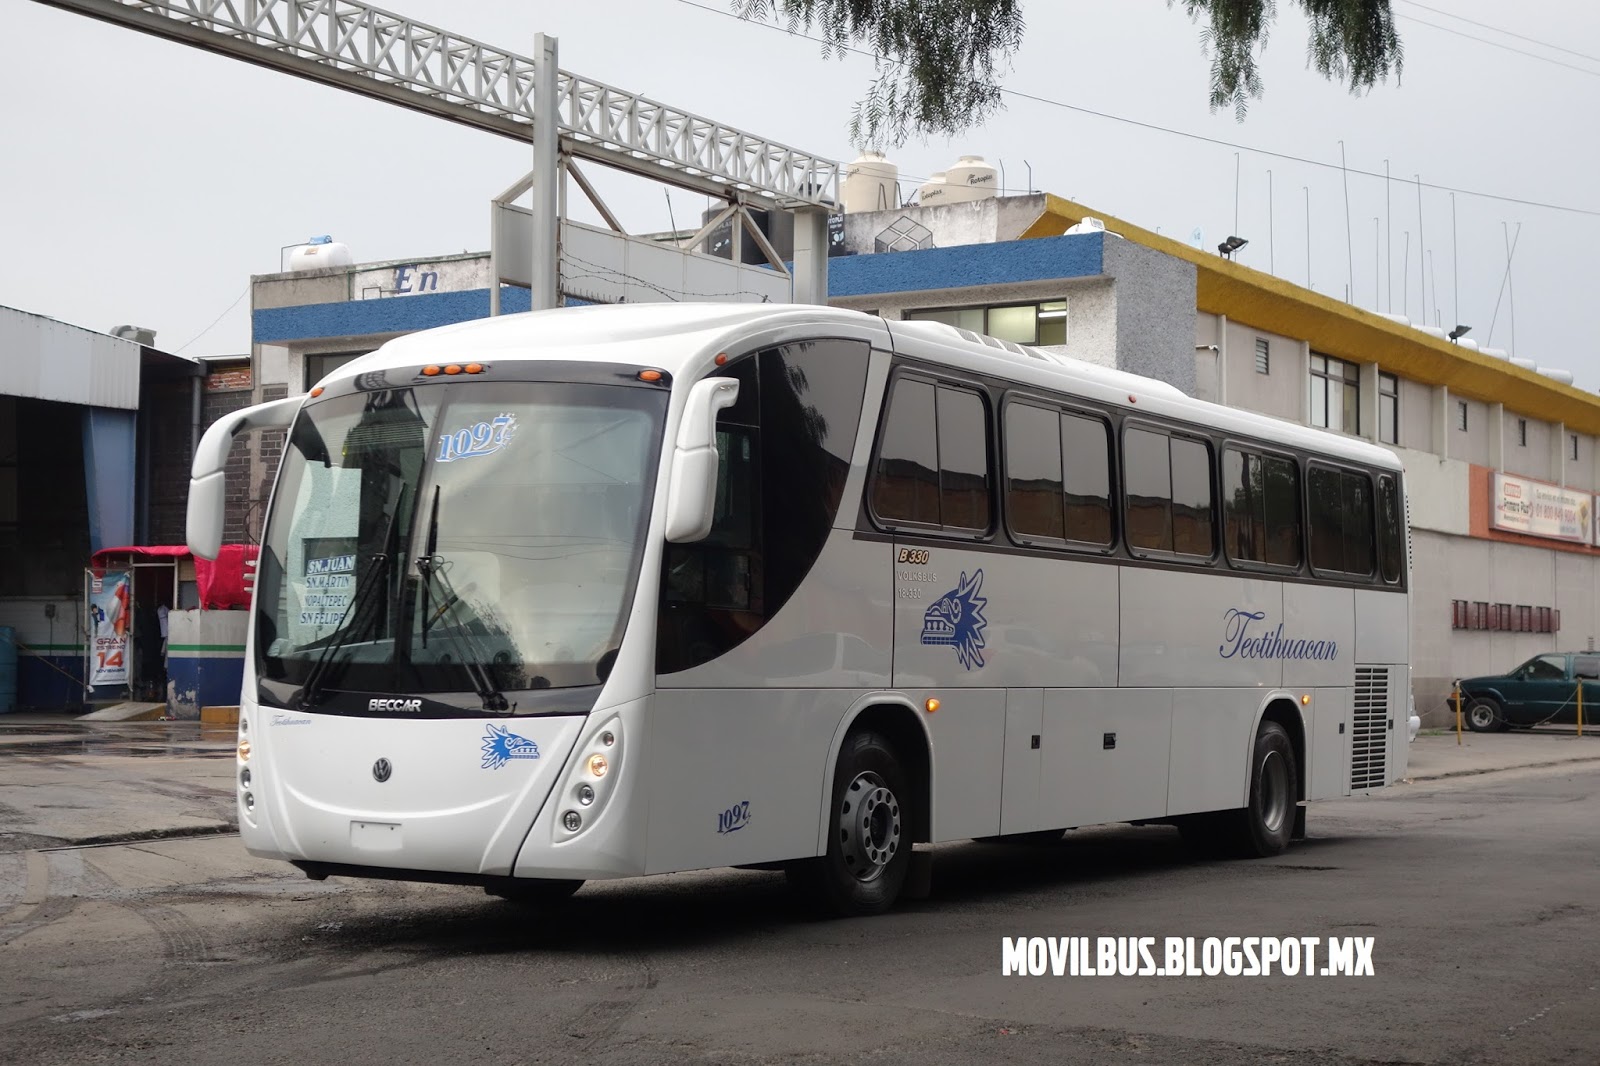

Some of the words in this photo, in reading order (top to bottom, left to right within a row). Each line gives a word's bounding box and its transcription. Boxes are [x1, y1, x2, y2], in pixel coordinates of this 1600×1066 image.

[395, 264, 438, 293] En
[435, 416, 512, 462] 1097
[898, 548, 909, 563] B
[908, 549, 929, 564] 330
[897, 571, 938, 582] VOLKSBUS
[96, 637, 126, 645] GRAN
[1219, 608, 1338, 661] Teotihuacan
[96, 650, 124, 668] 14
[368, 698, 422, 712] BECCAR
[717, 800, 751, 835] 1097
